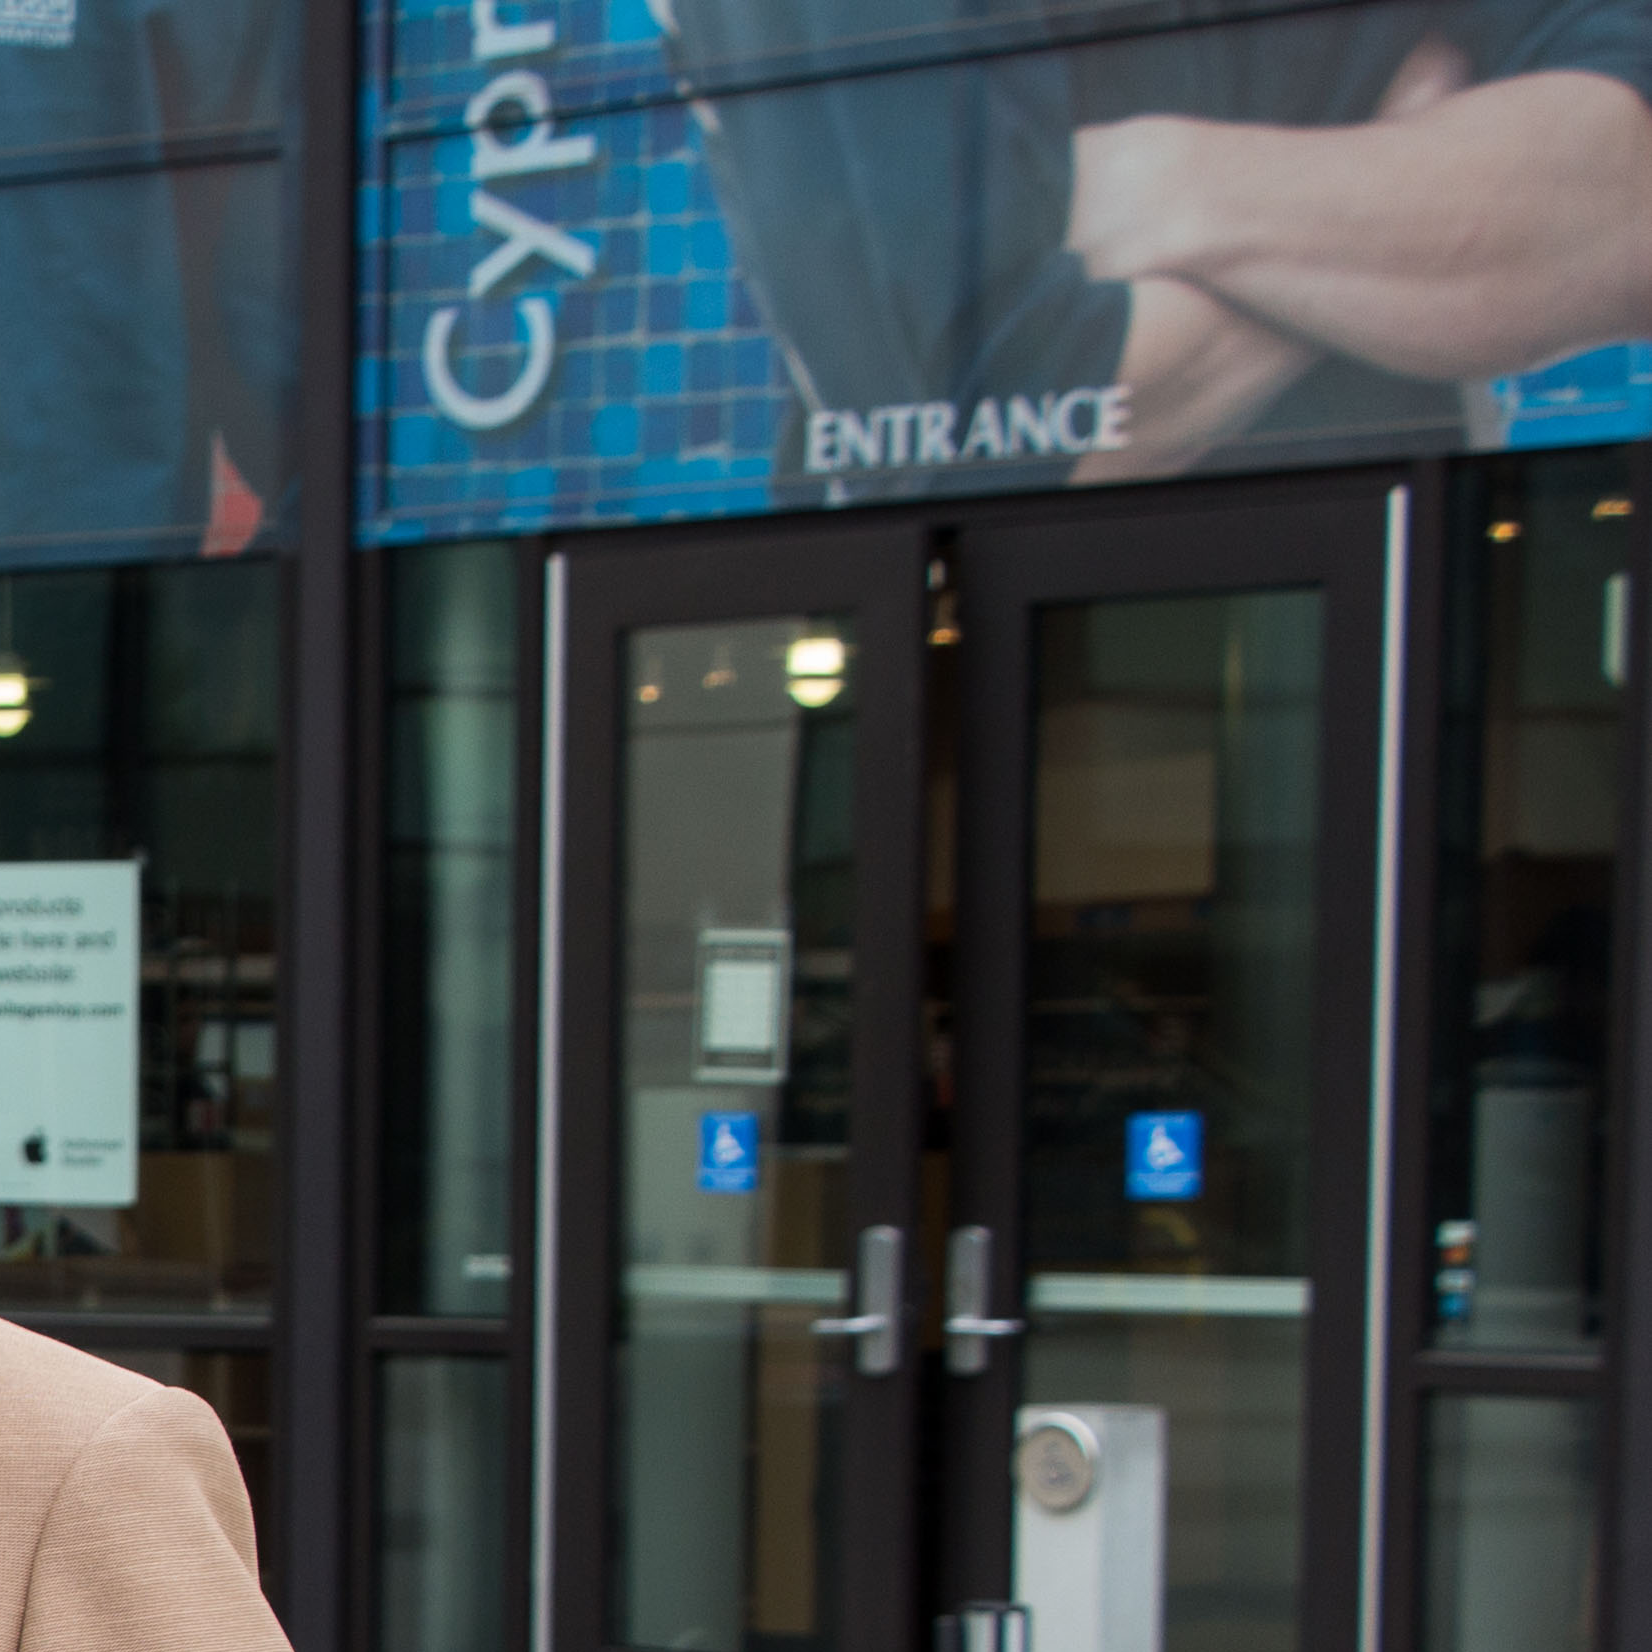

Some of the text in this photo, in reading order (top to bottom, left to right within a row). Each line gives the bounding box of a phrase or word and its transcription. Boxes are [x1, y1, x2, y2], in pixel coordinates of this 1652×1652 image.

[804, 384, 1134, 474] ENTRANCE
[20, 928, 66, 948] here
[75, 927, 116, 948] and
